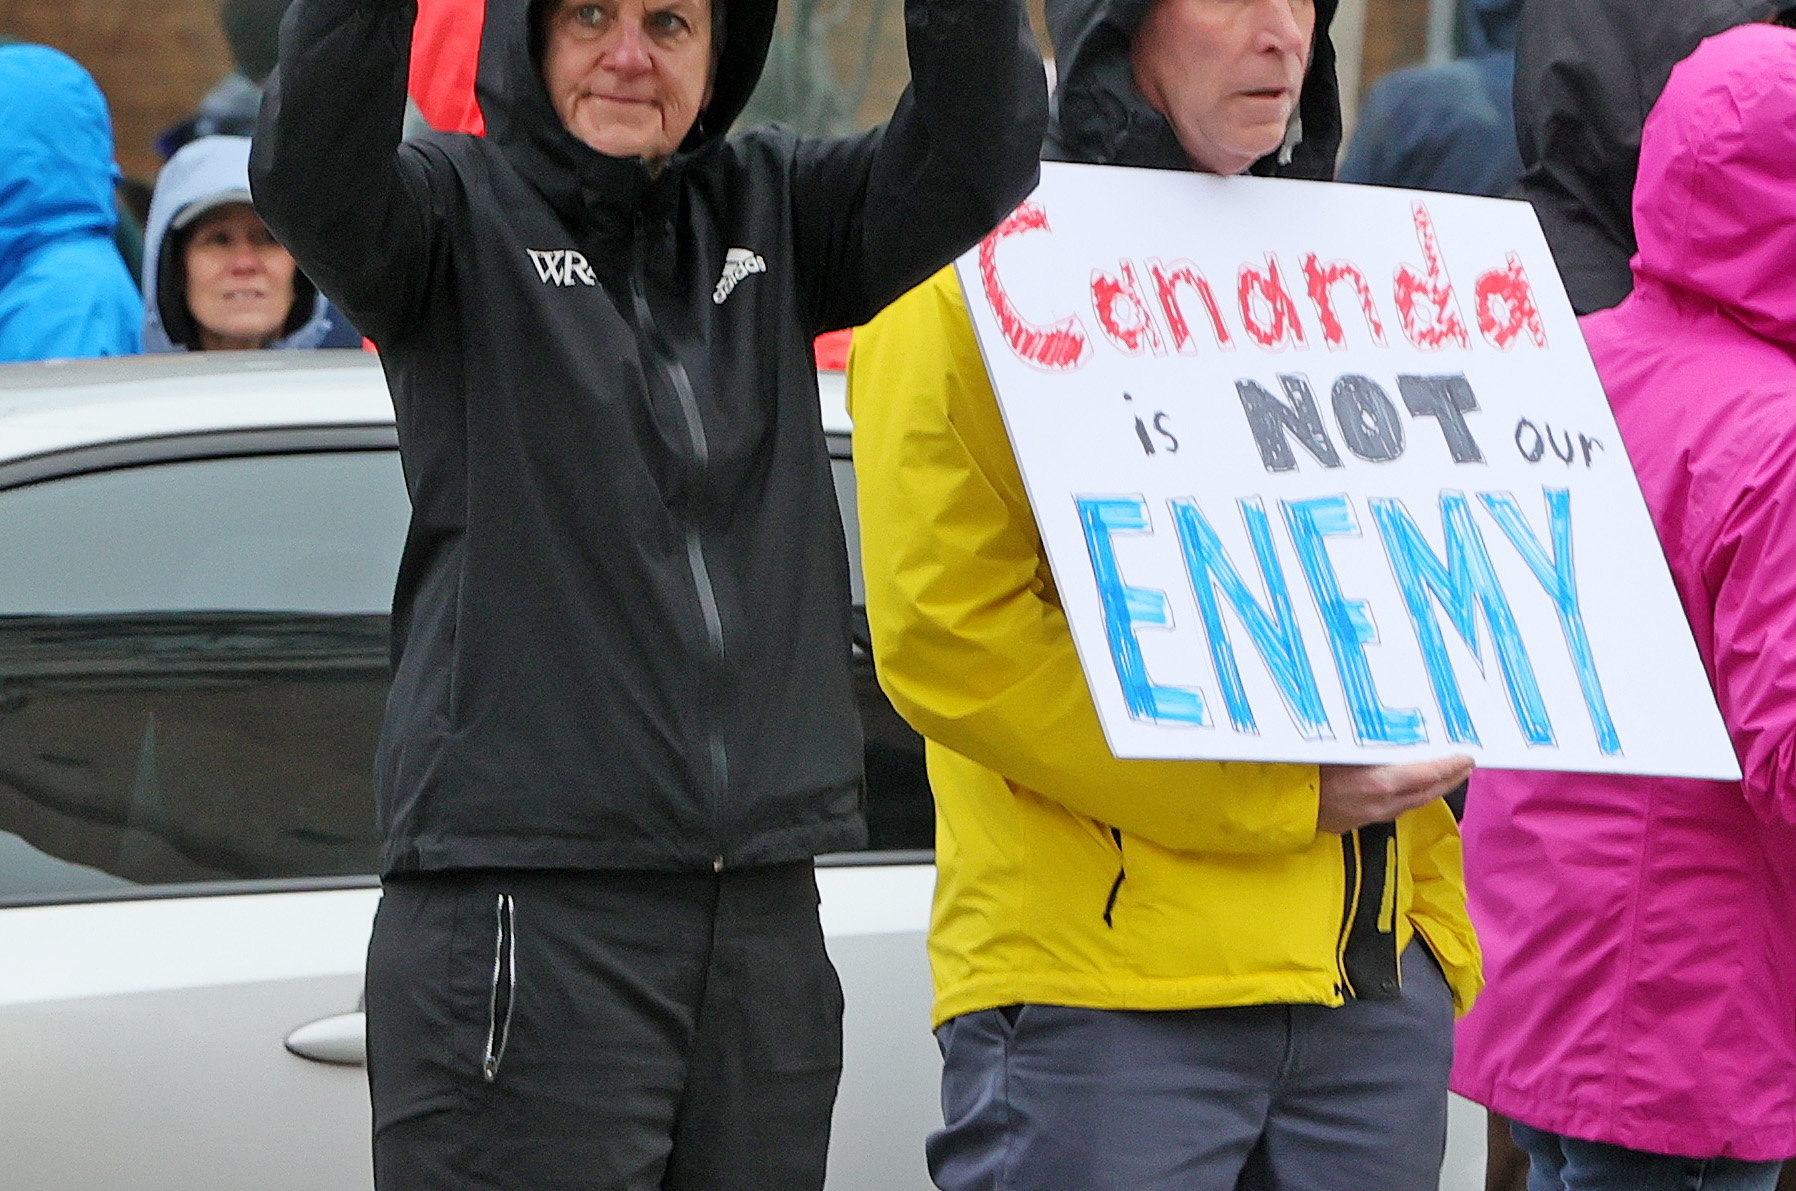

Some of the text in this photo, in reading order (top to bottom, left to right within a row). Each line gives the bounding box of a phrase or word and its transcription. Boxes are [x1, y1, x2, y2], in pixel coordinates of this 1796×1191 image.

[978, 199, 1548, 374] Cananda
[1122, 371, 1605, 473] is NOT our
[1073, 485, 1625, 757] ENEMY
